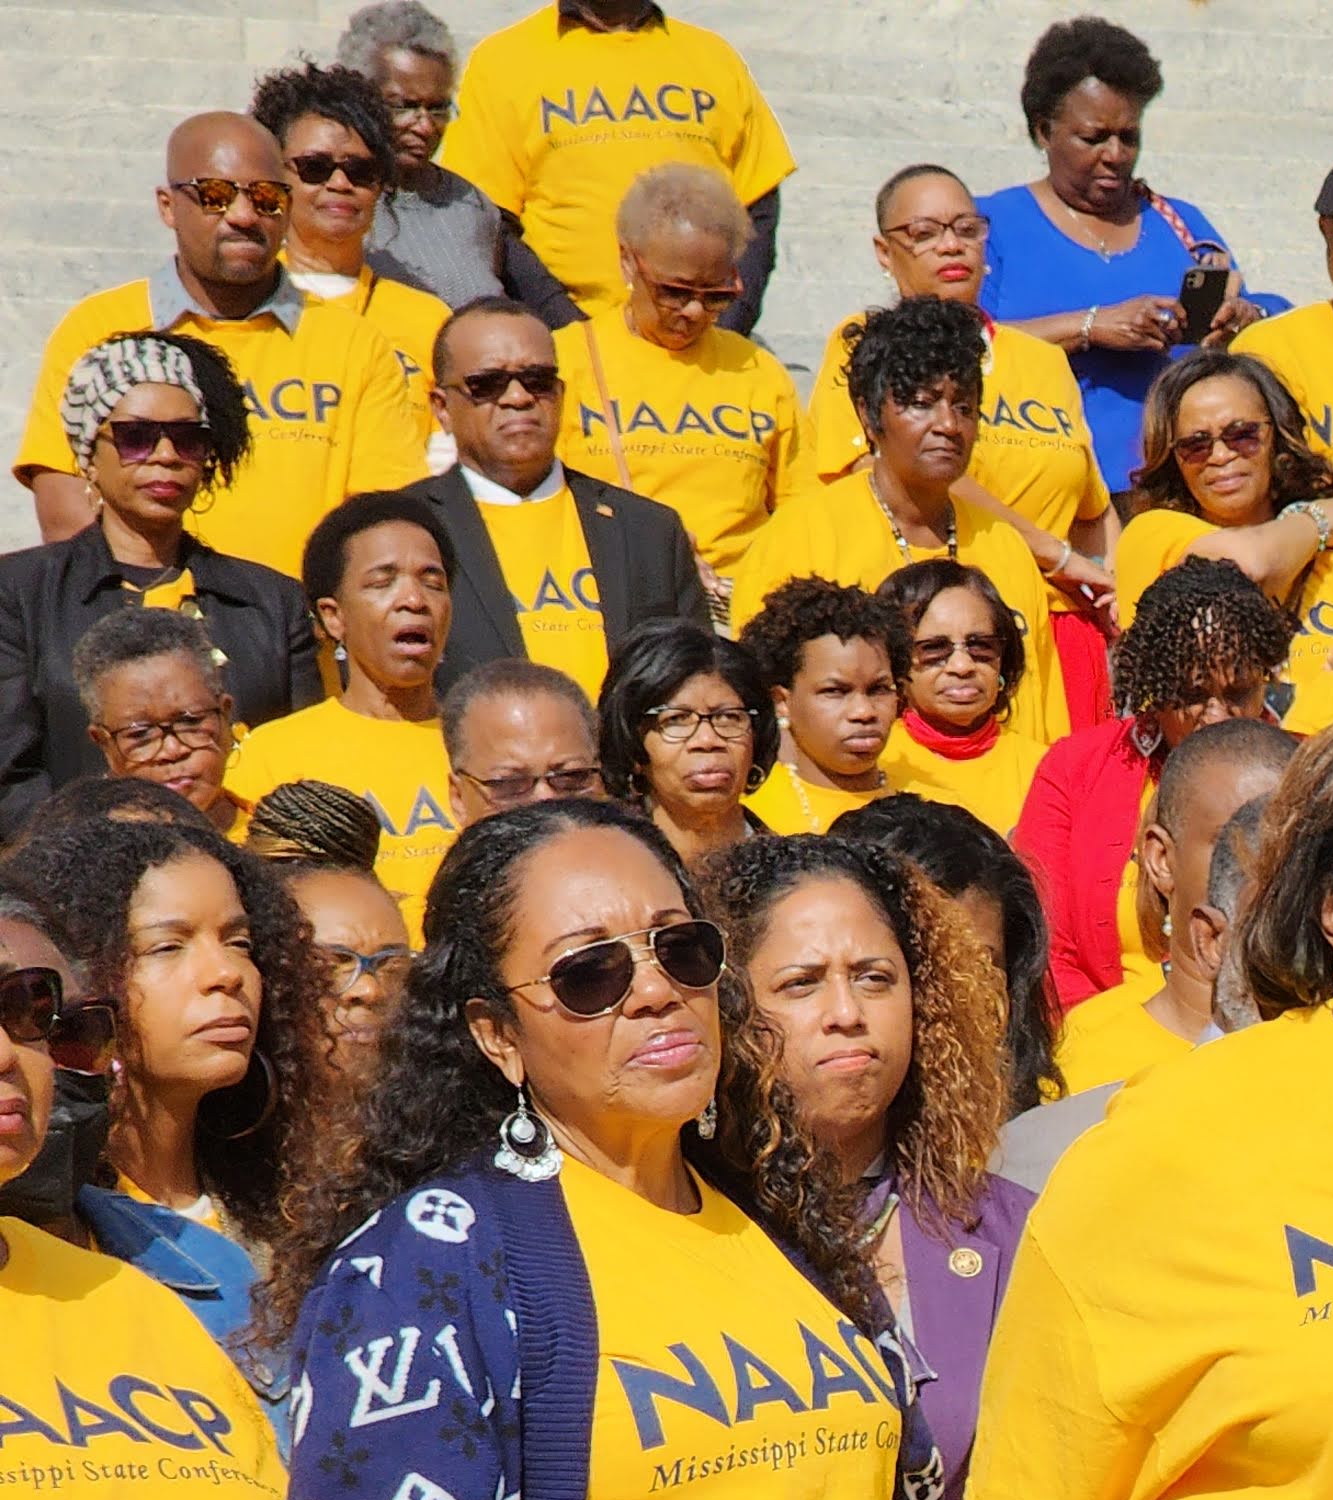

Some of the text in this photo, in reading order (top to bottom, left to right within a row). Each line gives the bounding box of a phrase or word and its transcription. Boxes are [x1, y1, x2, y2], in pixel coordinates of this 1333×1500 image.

[541, 84, 716, 134] NAACP
[243, 378, 342, 423] ACP
[580, 400, 776, 444] NAACP
[980, 394, 1073, 438] ACP
[610, 1319, 901, 1451] NAAC
[0, 1375, 235, 1457] AACP
[82, 1459, 150, 1482] State
[648, 1432, 806, 1493] Mississippi
[815, 1427, 869, 1455] State
